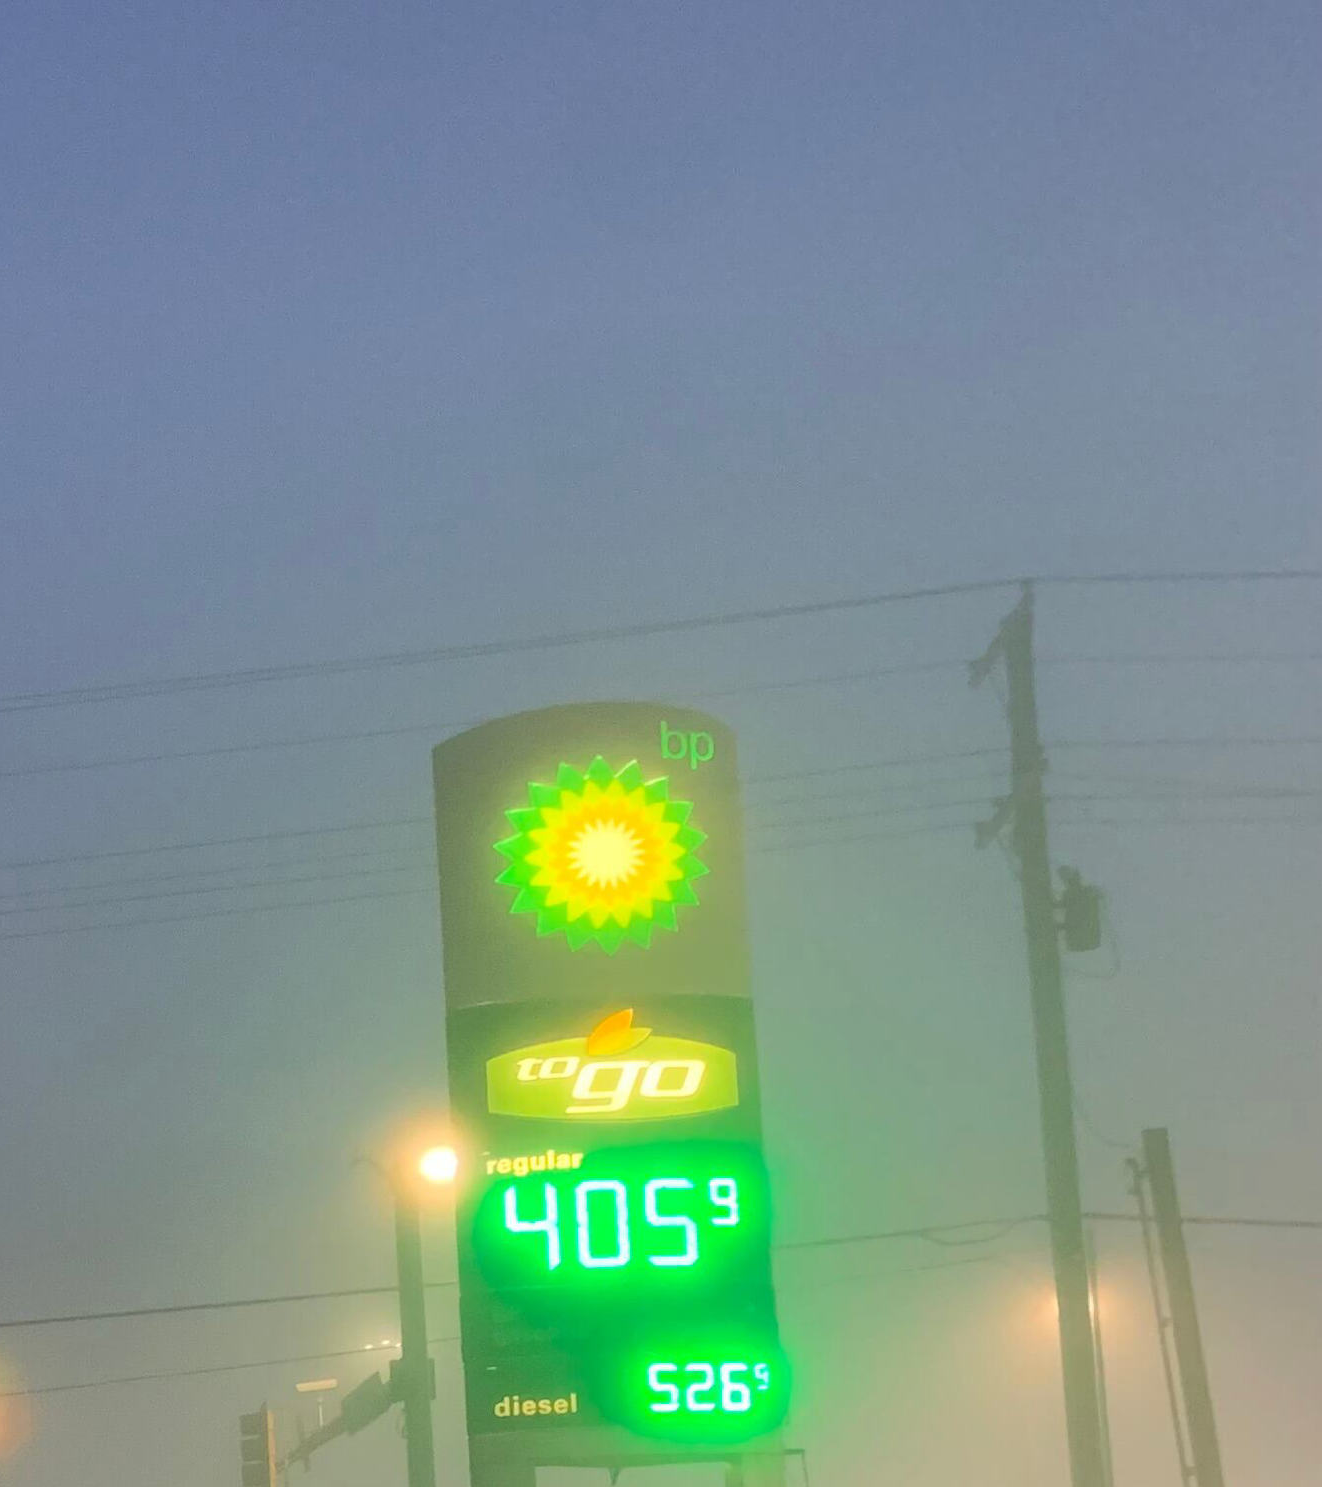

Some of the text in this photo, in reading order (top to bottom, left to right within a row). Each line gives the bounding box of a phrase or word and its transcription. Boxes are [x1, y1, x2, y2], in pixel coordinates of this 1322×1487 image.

[660, 720, 715, 769] bp
[485, 1149, 584, 1176] regular
[494, 1392, 578, 1417] diesel
